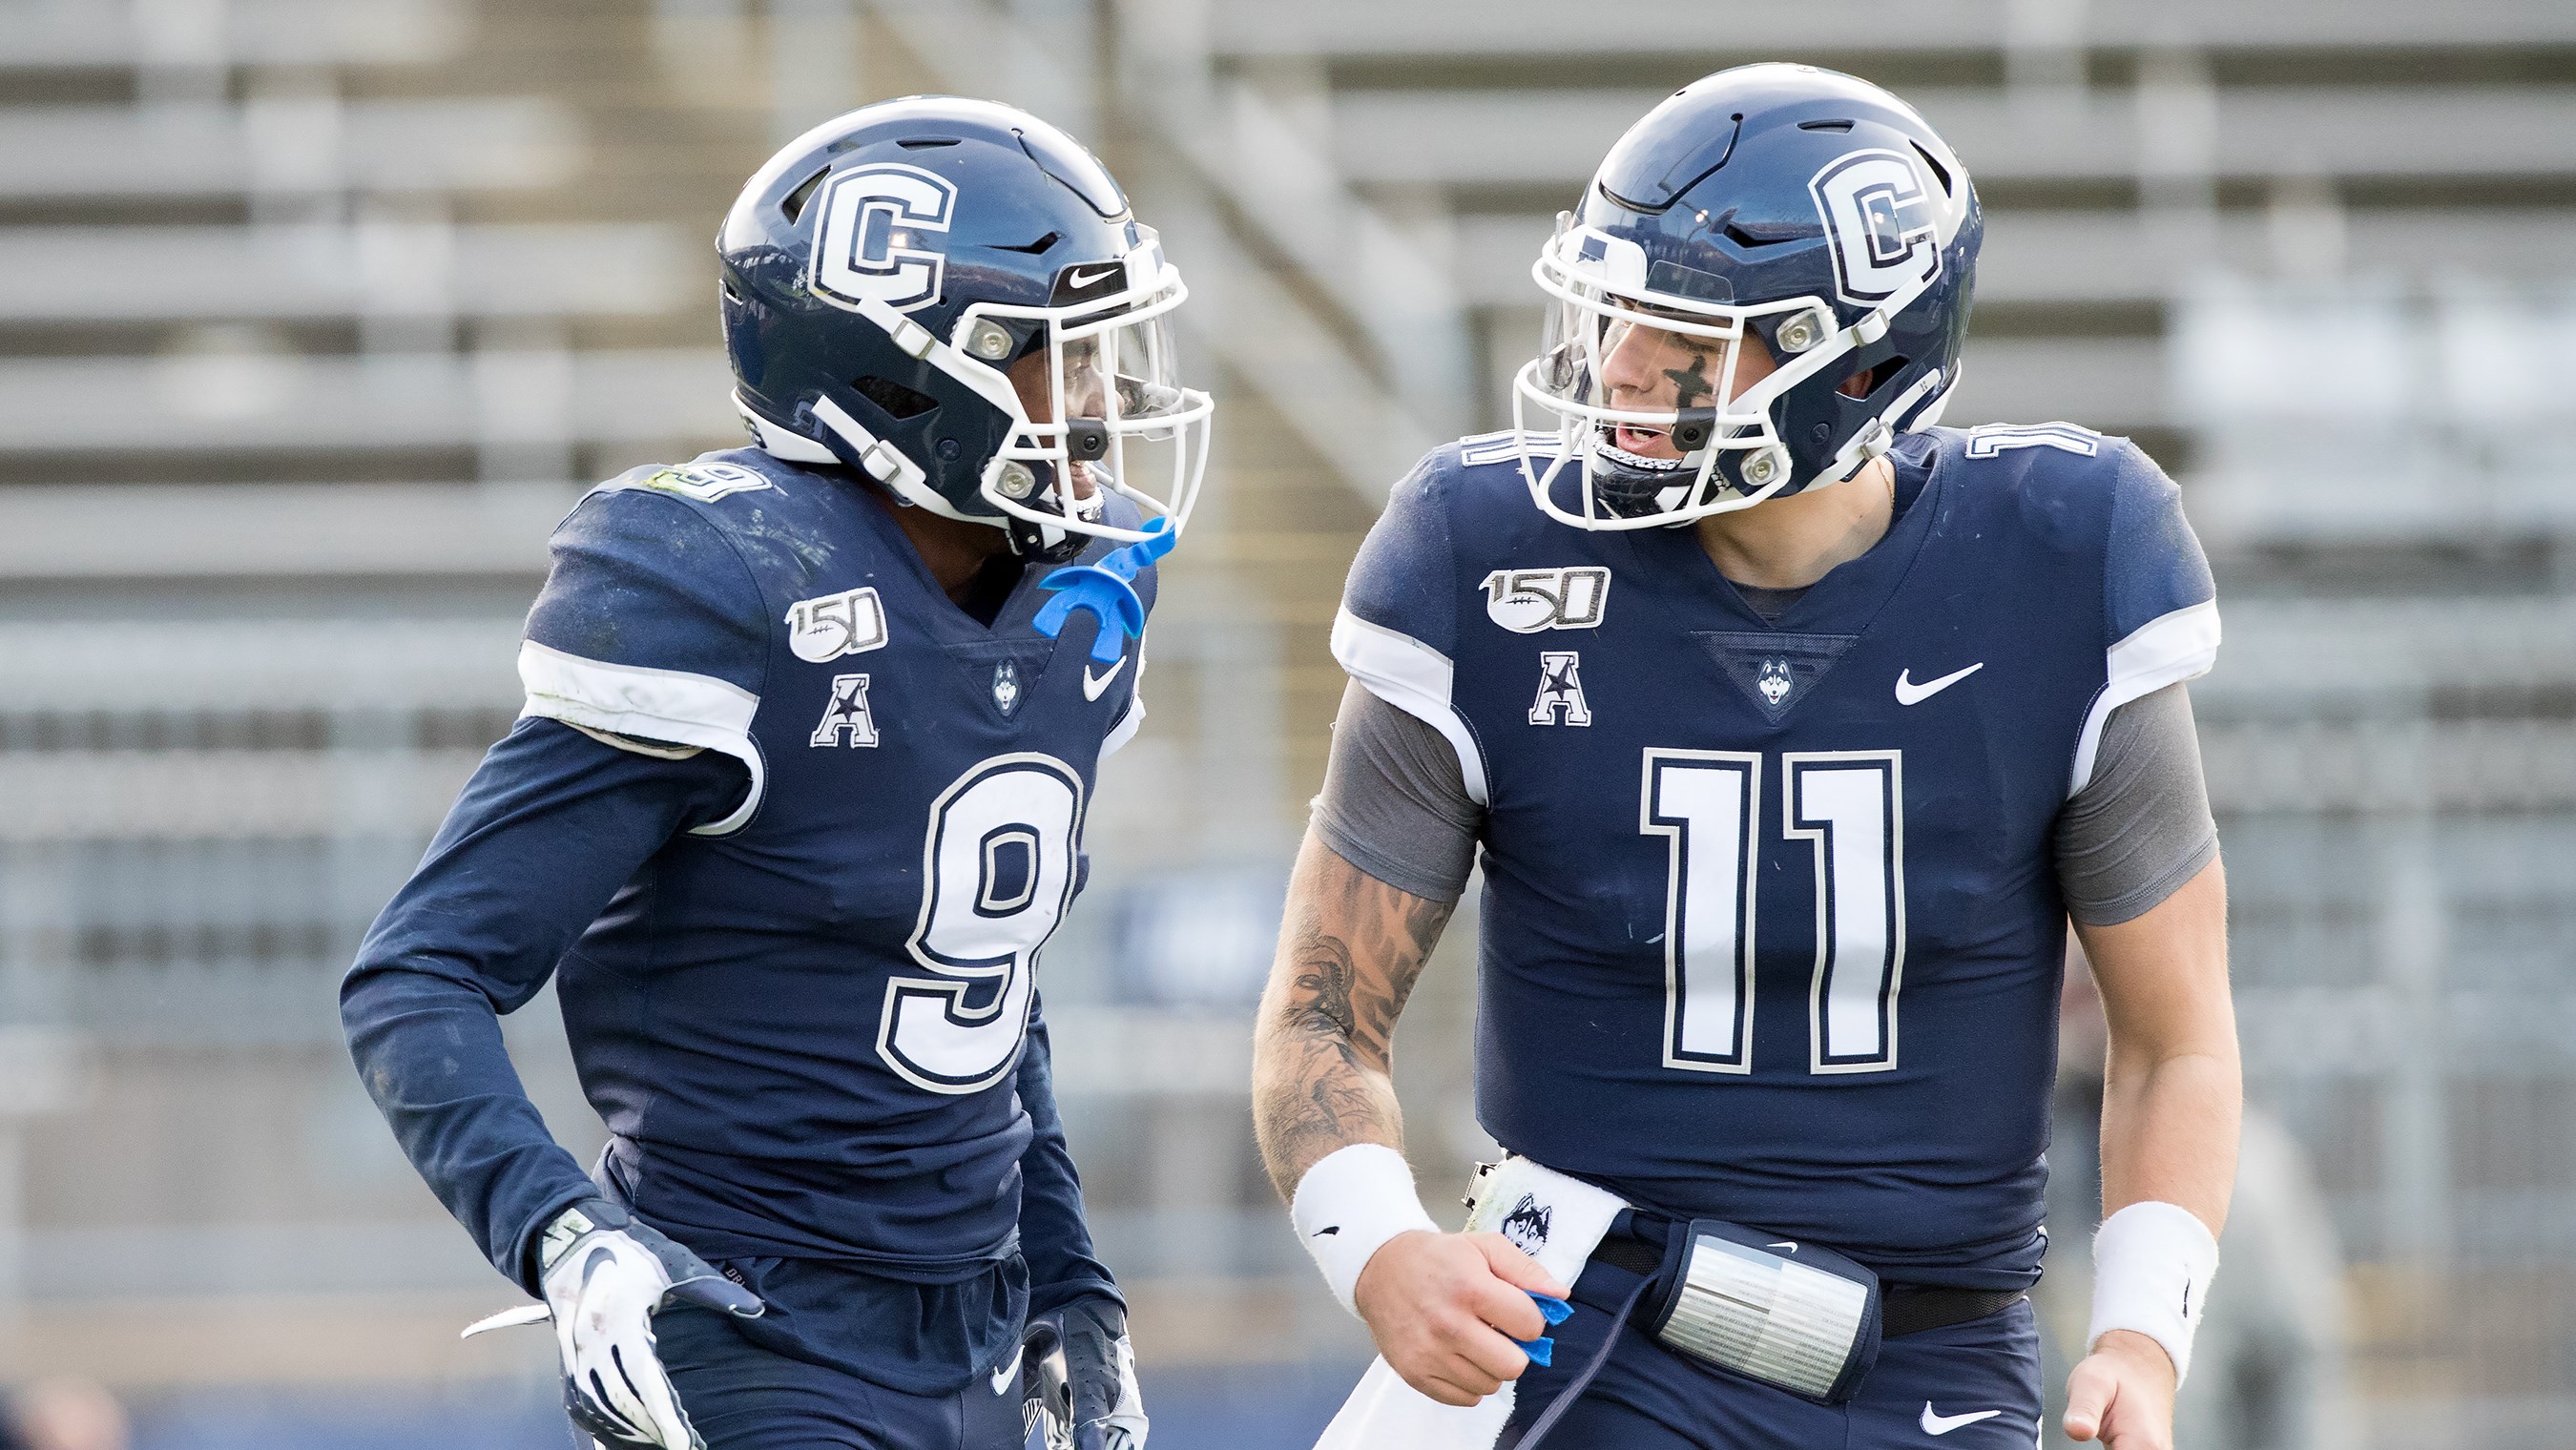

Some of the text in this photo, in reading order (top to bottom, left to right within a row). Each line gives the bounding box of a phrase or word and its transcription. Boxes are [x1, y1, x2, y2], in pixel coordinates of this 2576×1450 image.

[808, 162, 958, 313] C
[1808, 148, 1942, 307] C
[641, 462, 774, 504] 9
[789, 590, 886, 659] 150
[1485, 570, 1608, 630] 150
[810, 673, 879, 748] A
[1528, 651, 1591, 727] A
[876, 752, 1084, 1094] 9
[1639, 747, 1901, 1075] 11
